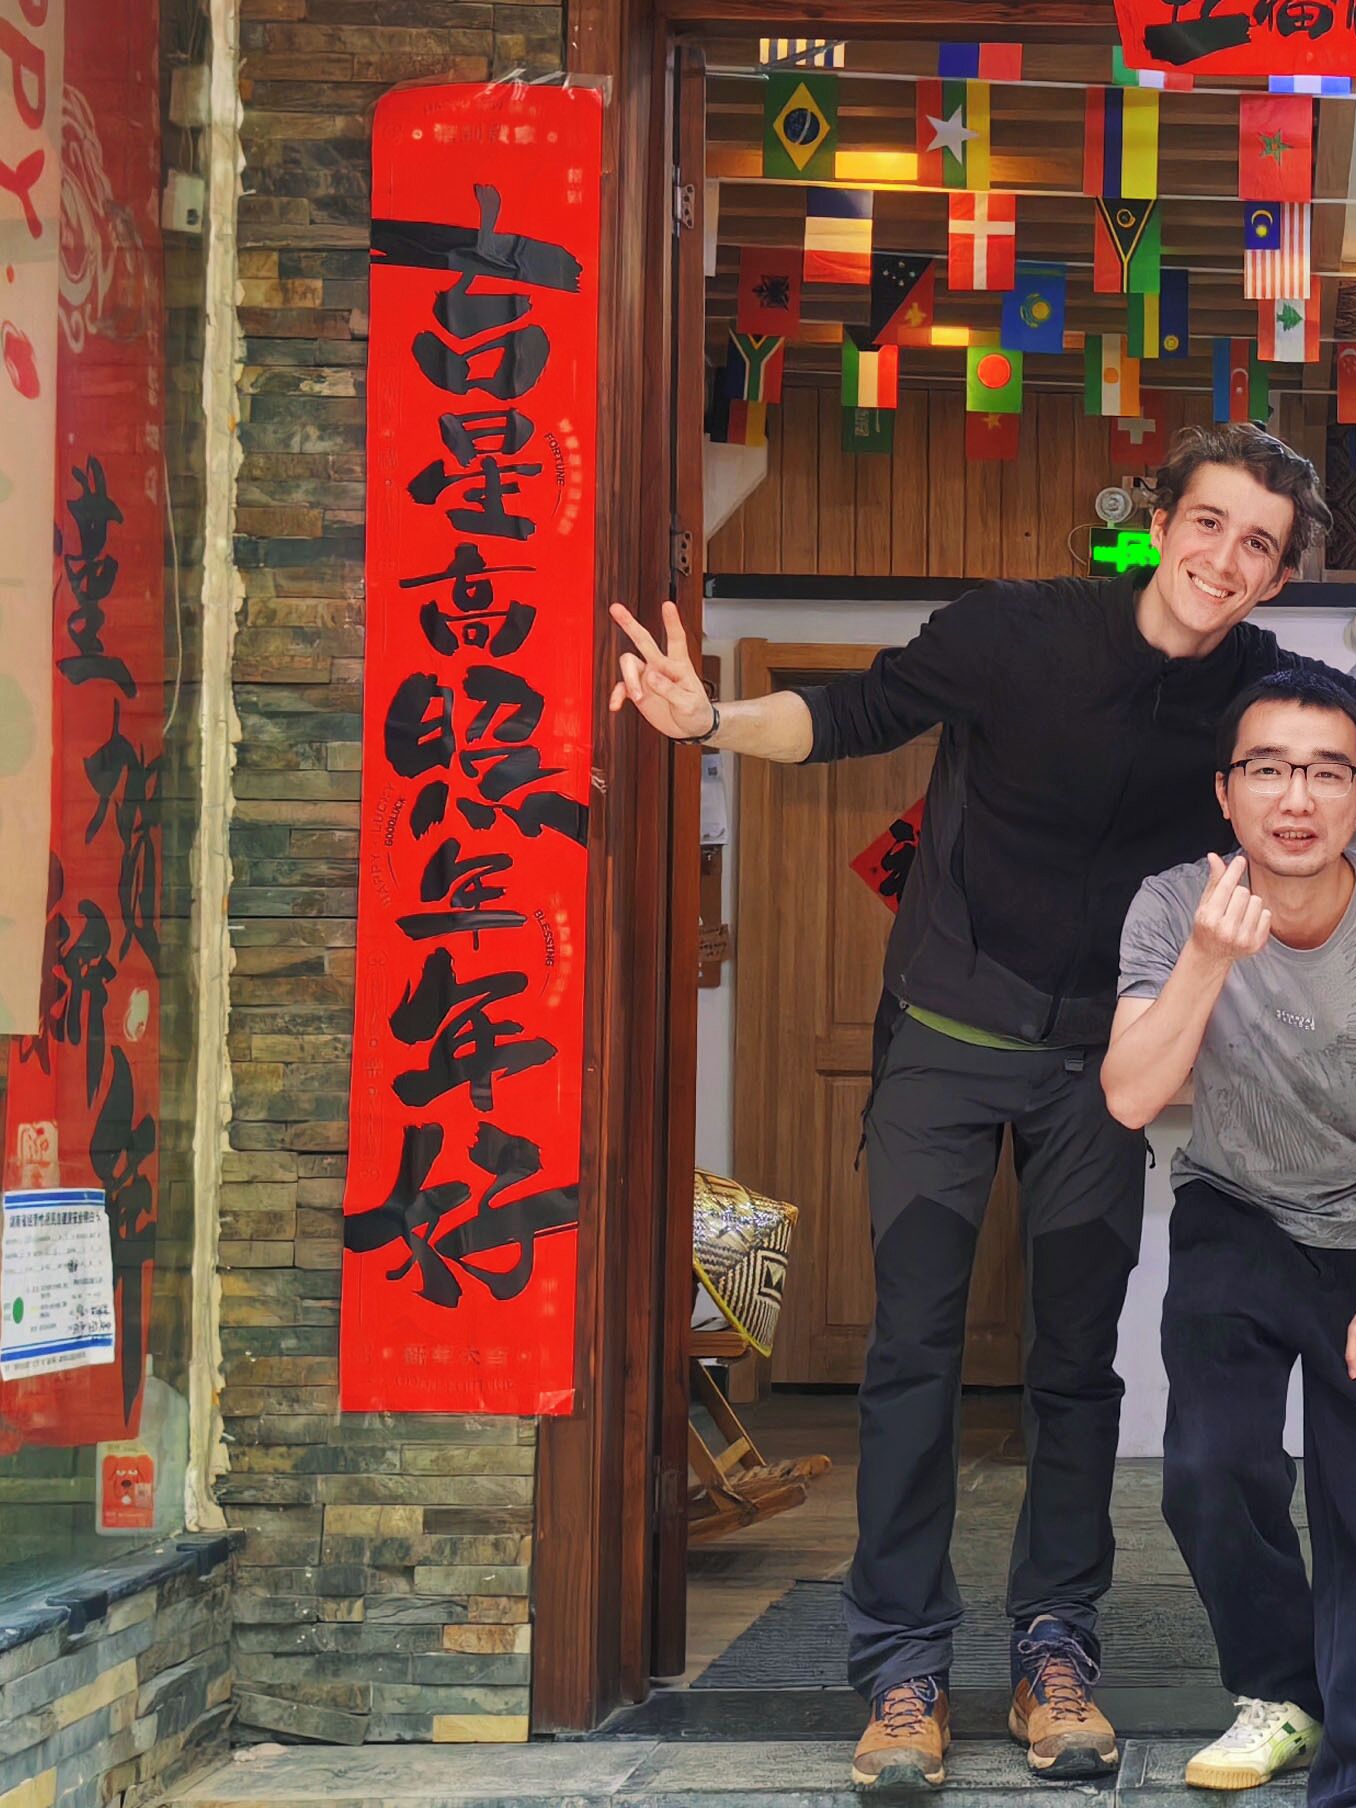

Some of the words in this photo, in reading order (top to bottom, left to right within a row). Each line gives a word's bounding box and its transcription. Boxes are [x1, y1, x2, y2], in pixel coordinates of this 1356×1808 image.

[544, 433, 565, 487] FORTUNE
[343, 183, 589, 1308] 吉星高照年年好
[534, 909, 555, 967] BLESSING
